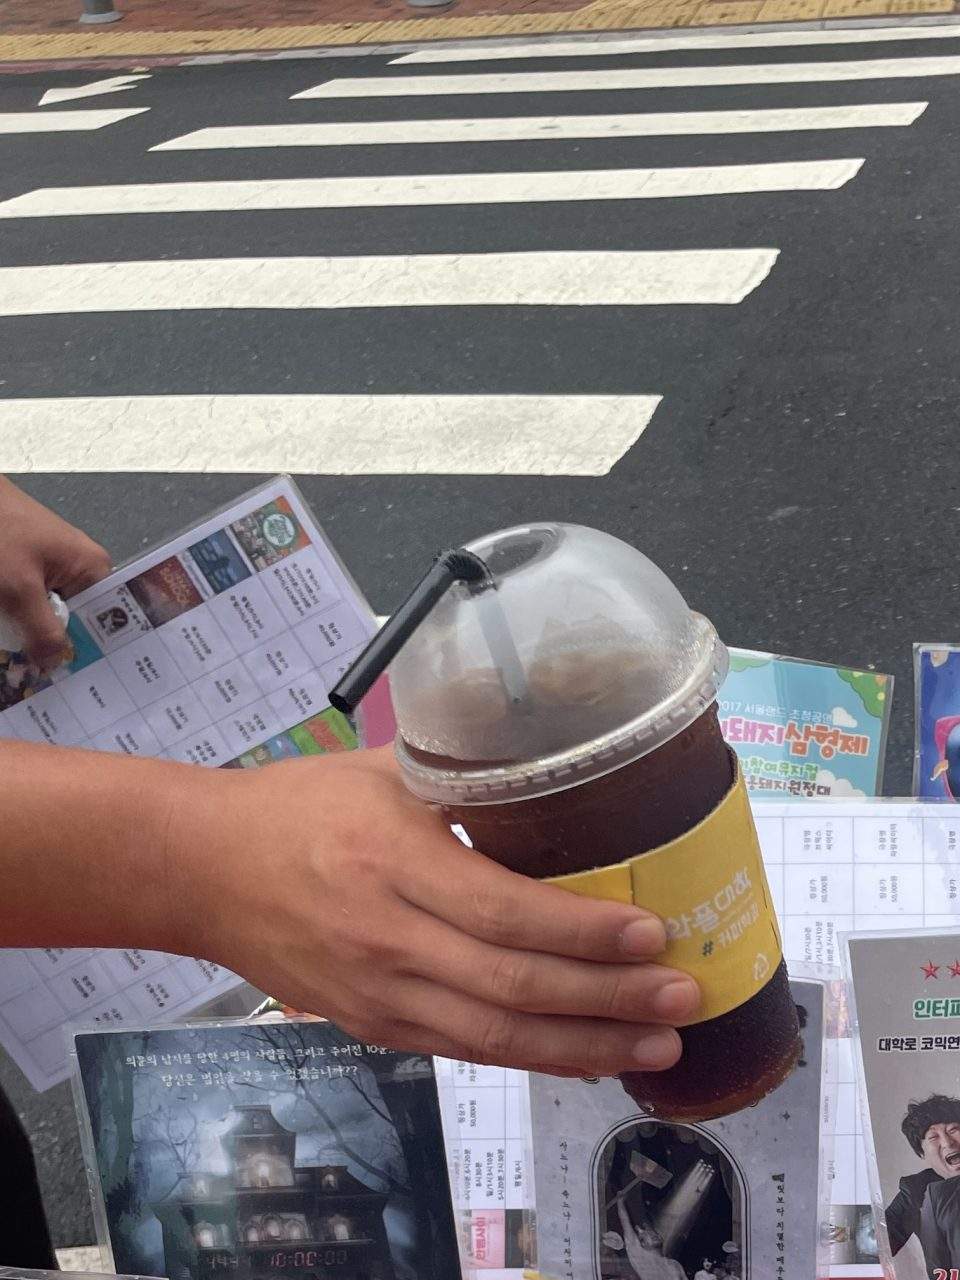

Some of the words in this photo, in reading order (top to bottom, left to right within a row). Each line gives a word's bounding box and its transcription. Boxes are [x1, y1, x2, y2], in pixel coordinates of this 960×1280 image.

[721, 716, 785, 746] 돼지
[785, 720, 870, 760] 삼형제
[739, 756, 818, 781] 참여뮤지컬
[331, 1045, 362, 1057] 주어진
[878, 1037, 917, 1052] 대학로
